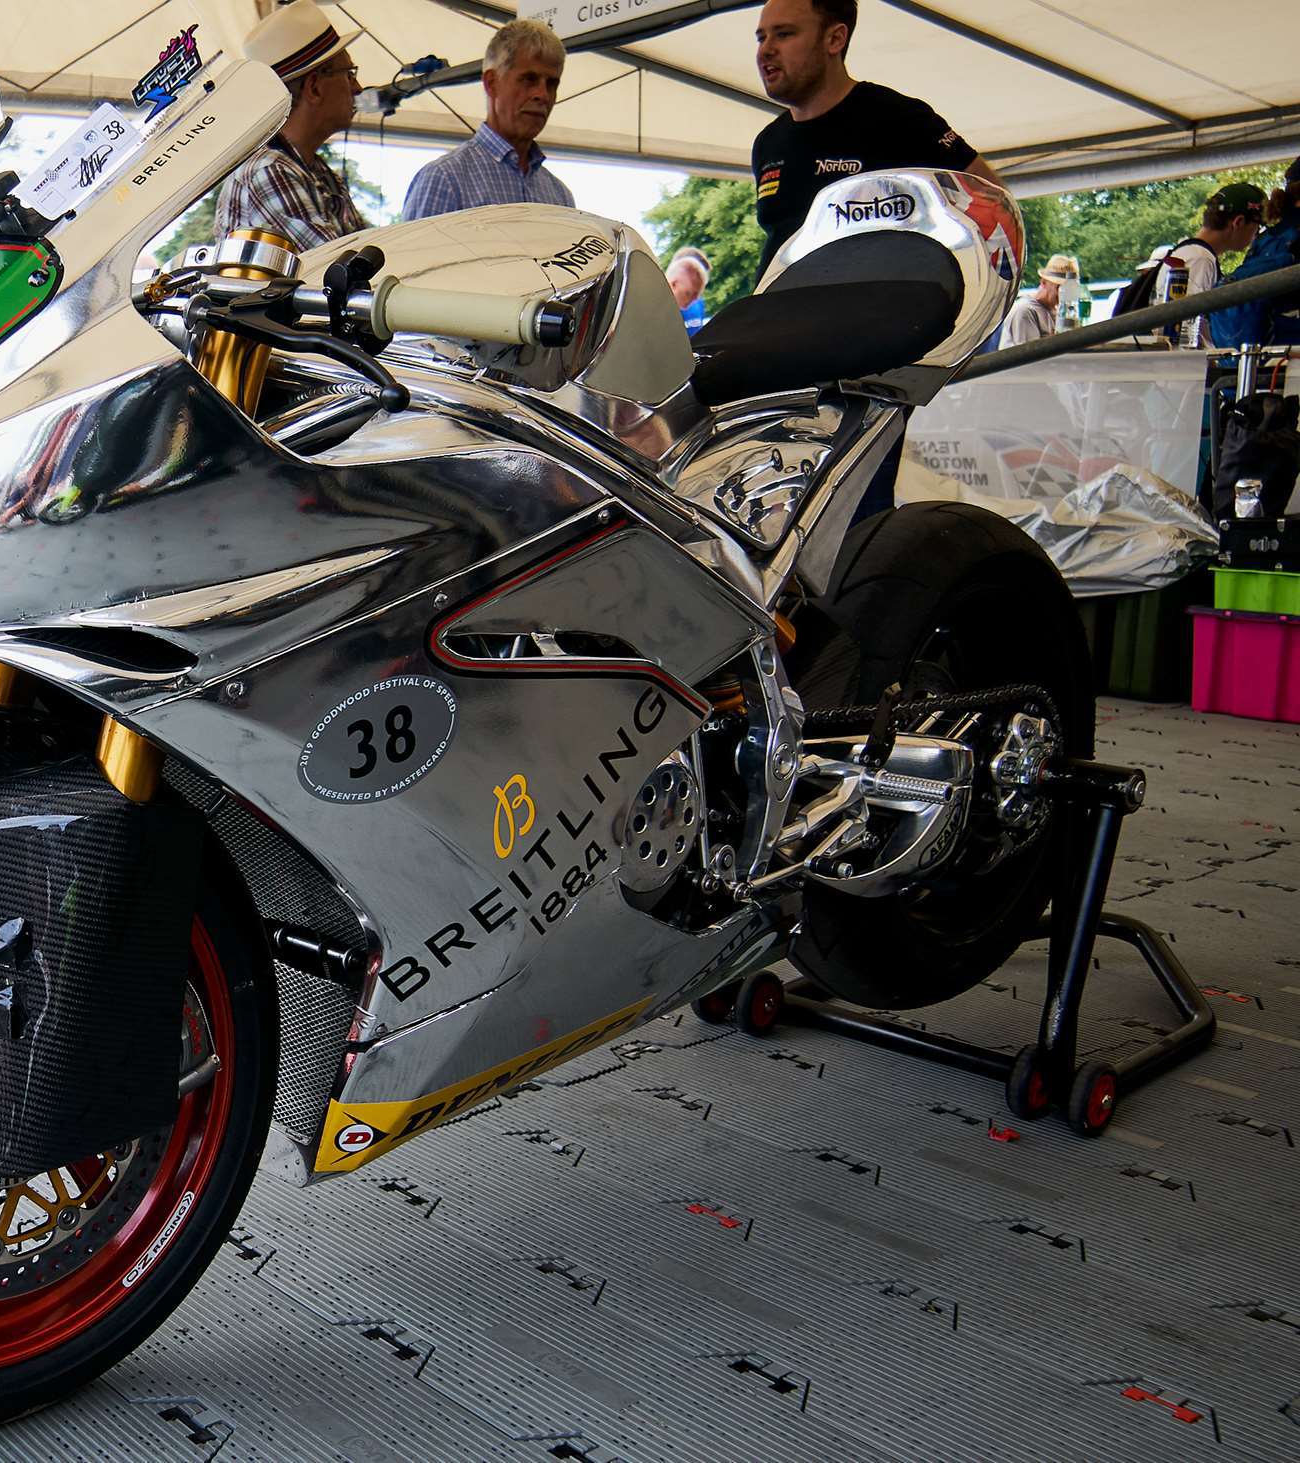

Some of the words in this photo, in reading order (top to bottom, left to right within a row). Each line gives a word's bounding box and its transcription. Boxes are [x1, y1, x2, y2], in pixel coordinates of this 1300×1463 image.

[577, 1, 620, 22] Class
[102, 120, 125, 140] 38
[132, 115, 216, 186] BREITLING
[814, 159, 862, 175] Norton
[828, 193, 915, 229] Norton
[541, 235, 614, 280] Norton
[300, 742, 314, 767] 2019
[311, 688, 371, 740] GOODWOOD
[373, 677, 420, 693] FESTIVAL
[422, 679, 436, 689] OF
[436, 685, 456, 713] SPEED
[347, 705, 416, 779] 38
[314, 784, 371, 801] PRESENTED
[375, 788, 388, 798] BY
[391, 740, 447, 793] MASTERCARD
[378, 686, 668, 1002] BREITLING
[529, 841, 607, 936] 1884
[152, 1205, 187, 1254] RACING
